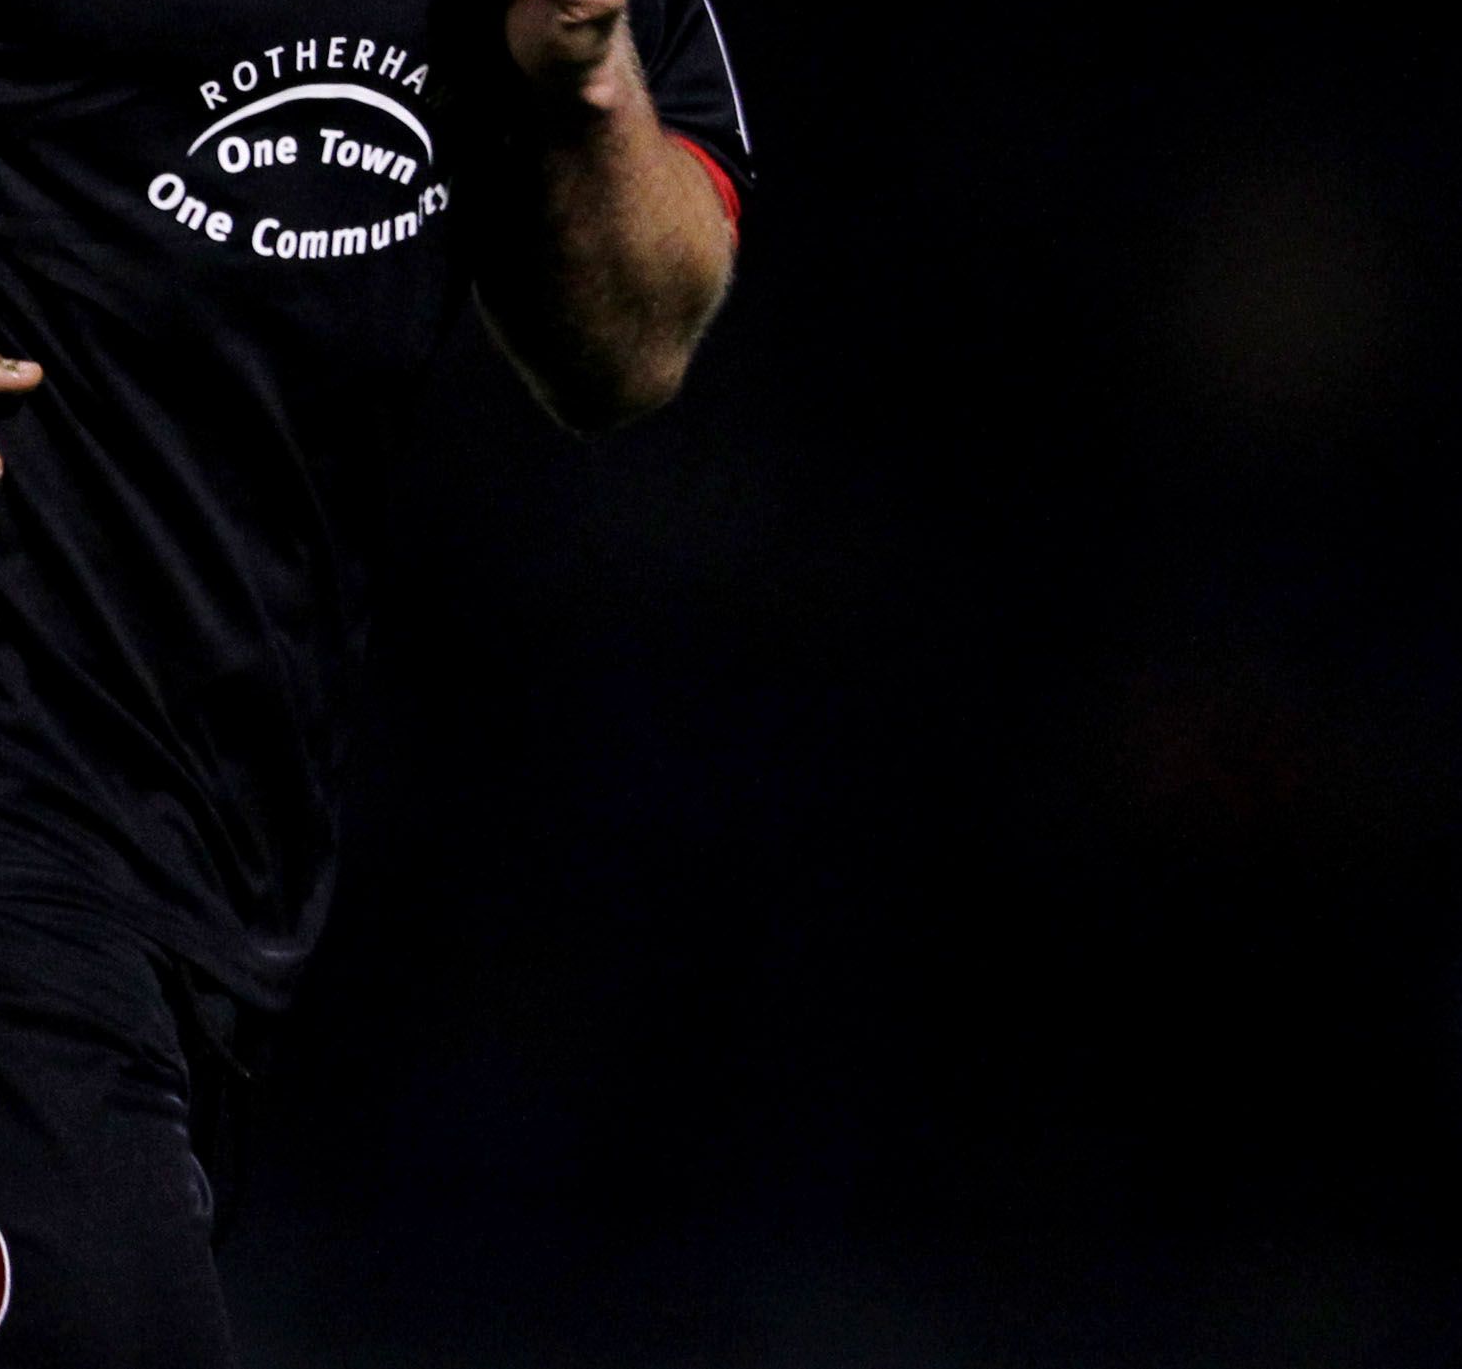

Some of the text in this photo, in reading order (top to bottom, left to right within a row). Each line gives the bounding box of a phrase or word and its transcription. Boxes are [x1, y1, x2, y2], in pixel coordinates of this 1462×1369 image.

[200, 37, 432, 110] ROTHERHA
[217, 128, 417, 184] One Town
[148, 173, 233, 242] One
